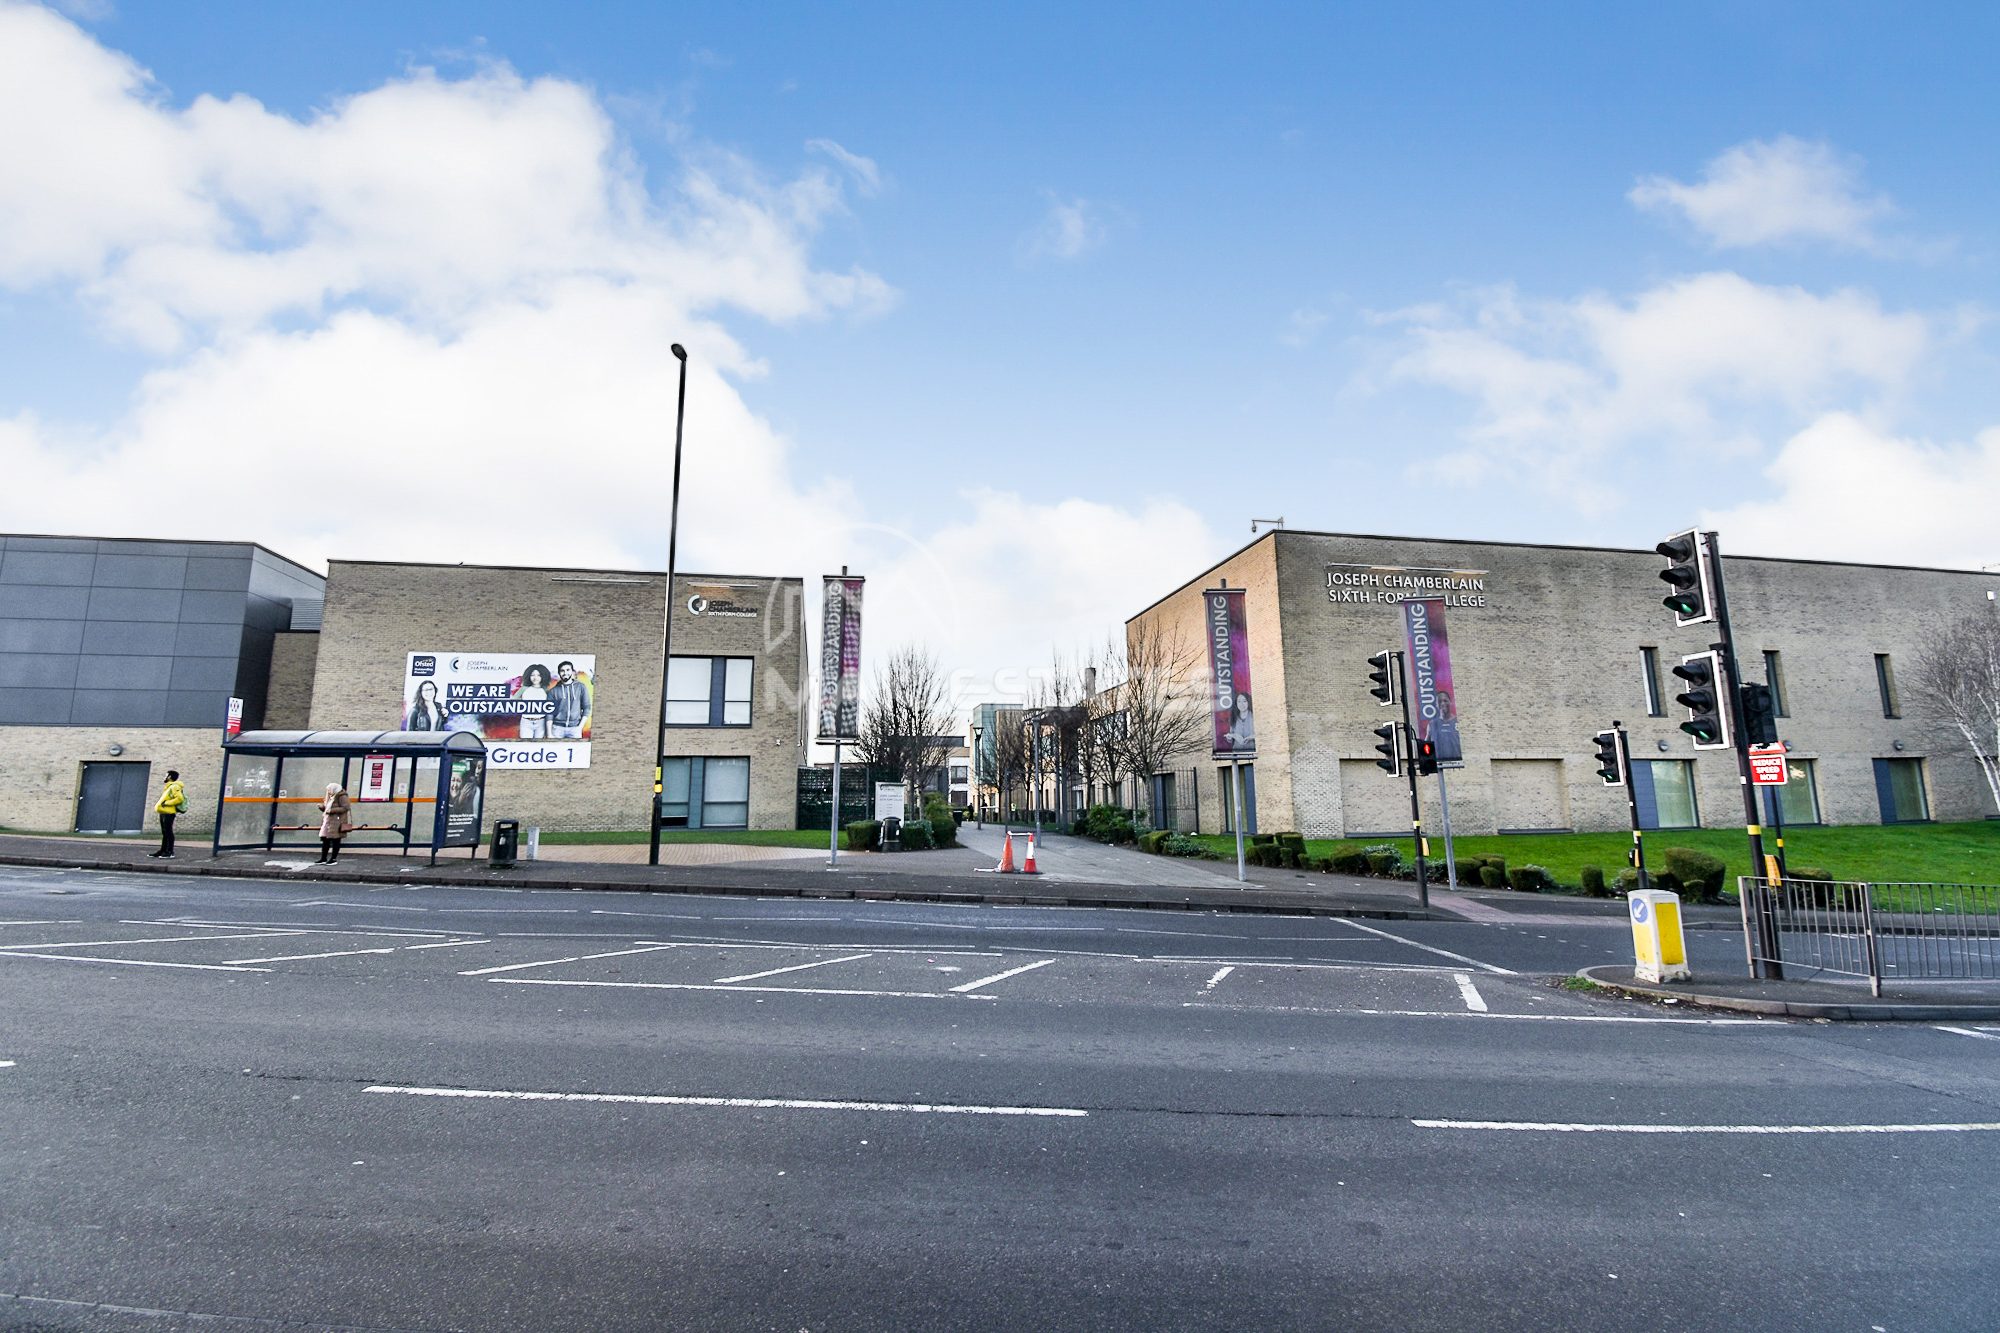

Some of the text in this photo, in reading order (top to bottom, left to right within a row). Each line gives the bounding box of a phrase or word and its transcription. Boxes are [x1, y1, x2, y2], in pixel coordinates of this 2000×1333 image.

[1326, 572, 1484, 592] JOSEPH CHAMBERLAIN
[1328, 589, 1371, 603] SIXTH
[1377, 591, 1417, 604] FOR
[824, 582, 843, 695] OUTSTANDING
[1213, 595, 1233, 709] OUTSTANDING
[1410, 602, 1437, 719] OUTSTANDING
[451, 685, 507, 698] WE ARE
[449, 701, 556, 714] OUTSTANDING
[491, 748, 574, 764] Grade 1
[1752, 758, 1782, 767] REDUCE
[1755, 766, 1781, 774] SPEED
[1759, 773, 1778, 781] NOW
